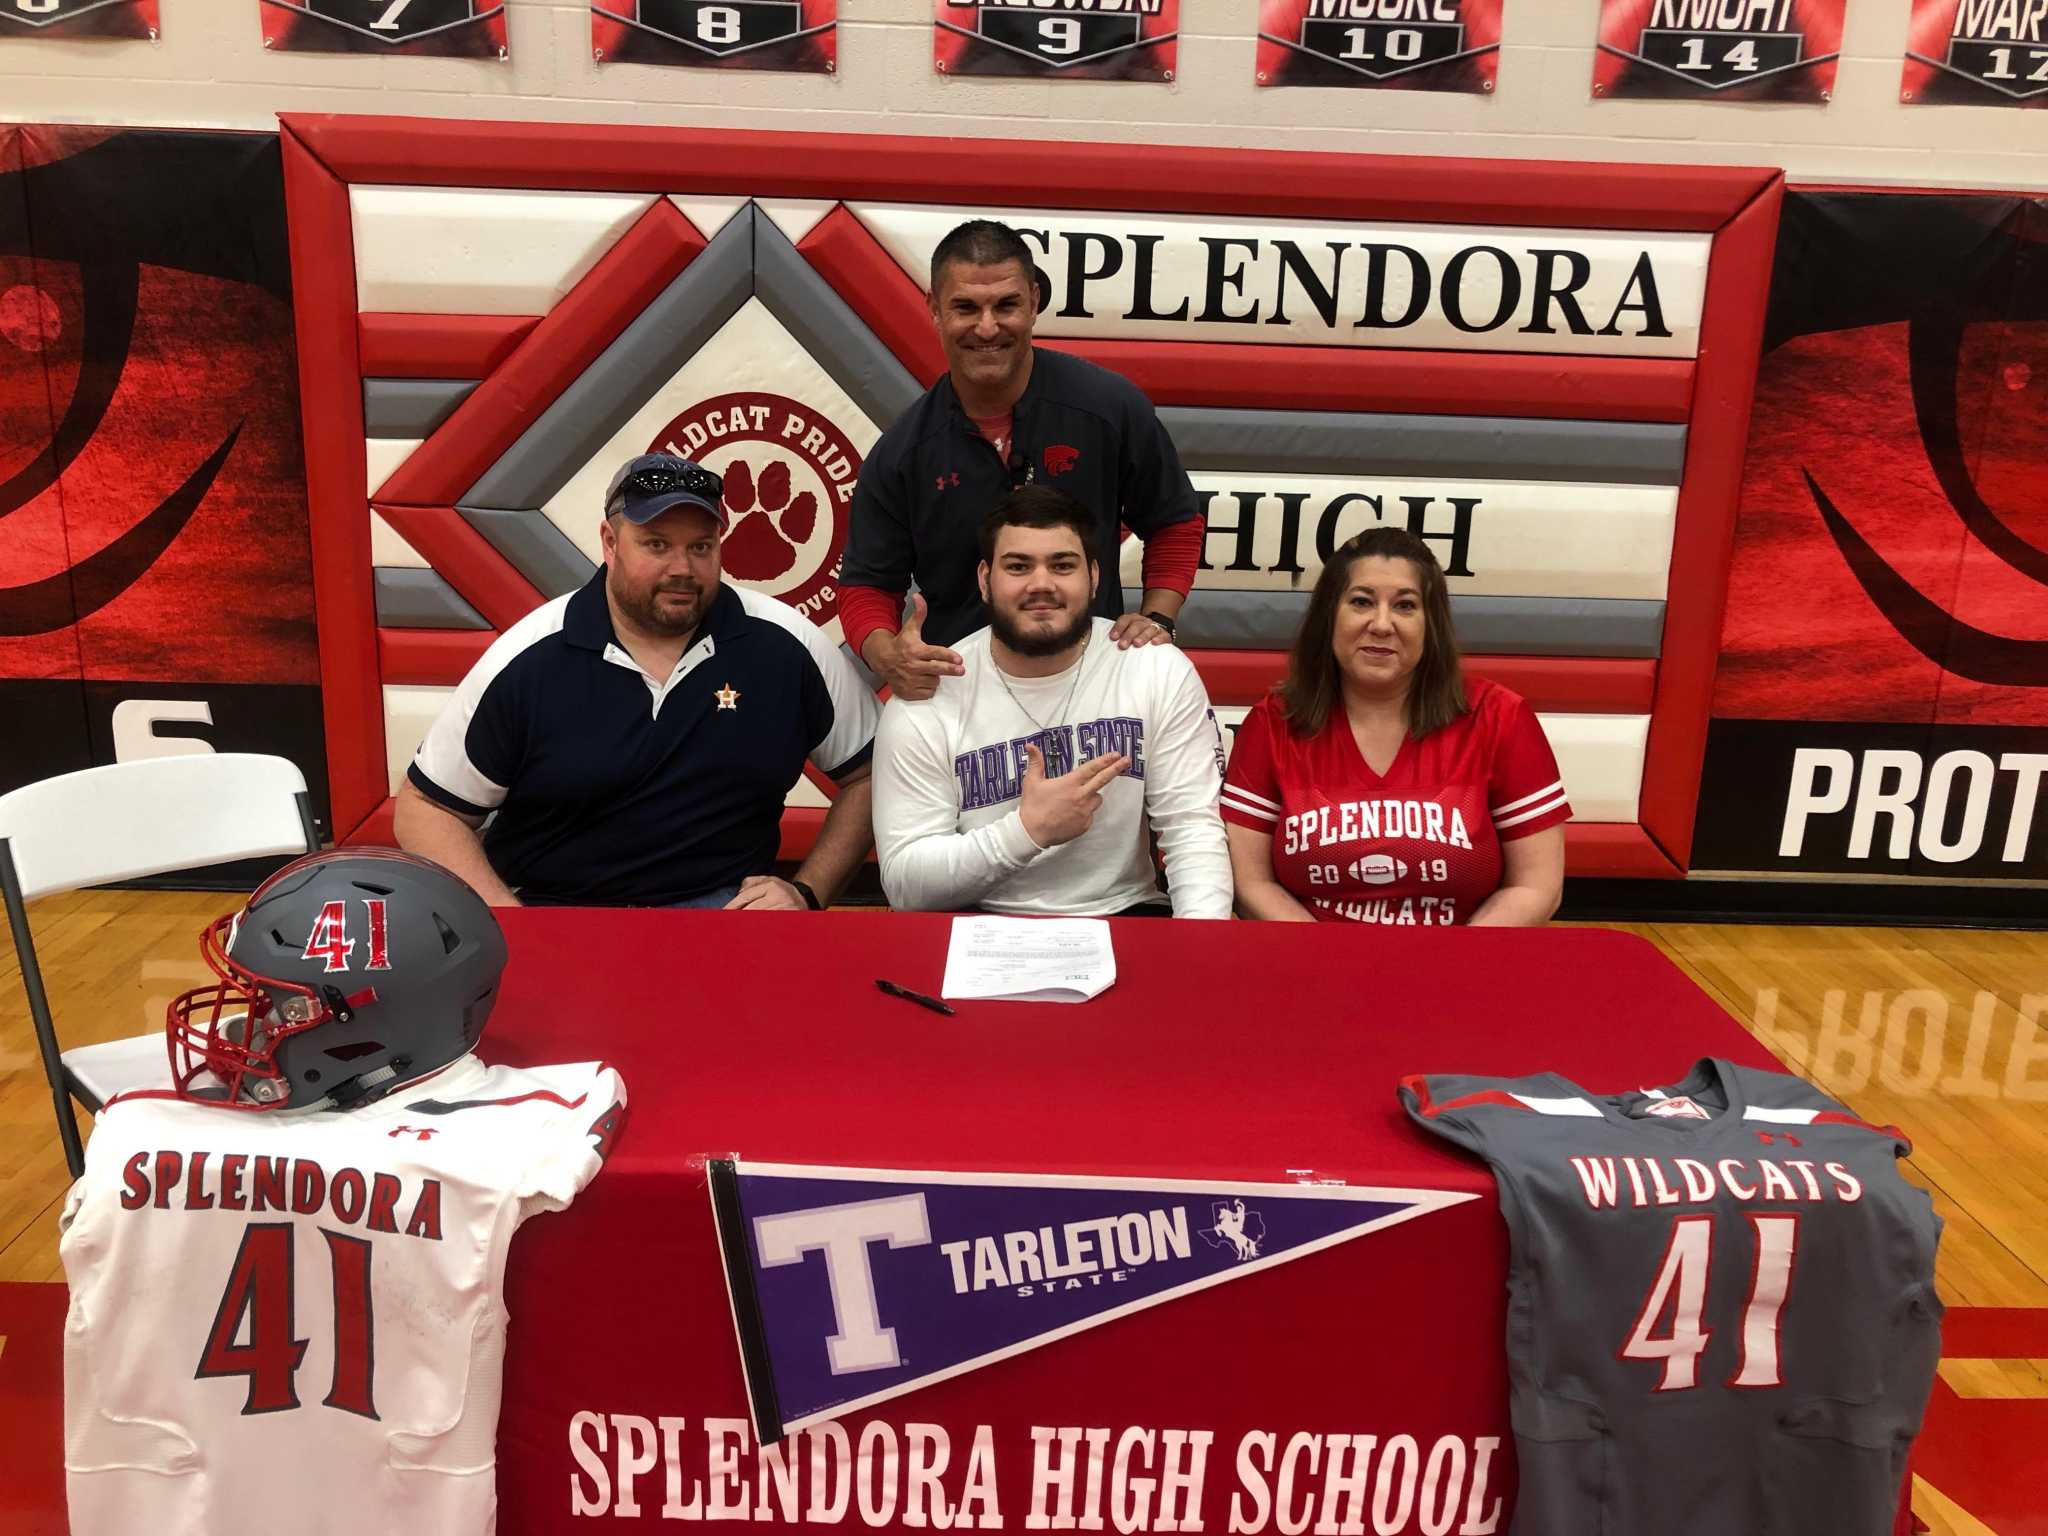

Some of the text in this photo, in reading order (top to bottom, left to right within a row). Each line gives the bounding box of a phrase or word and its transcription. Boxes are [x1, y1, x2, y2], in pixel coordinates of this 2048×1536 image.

[697, 6, 740, 43] 8
[1038, 18, 1081, 54] 9
[1339, 28, 1422, 61] 10
[1676, 39, 1760, 71] 14
[665, 405, 770, 460] LDCAT
[1285, 800, 1473, 855] SPLENDORA
[1308, 859, 1447, 884] 20 19
[301, 899, 392, 973] 41
[120, 1150, 443, 1241] SPLENDORA
[1569, 1156, 1865, 1209] WILDCATS
[940, 1206, 1192, 1294] TARLETON
[752, 1192, 932, 1375] T
[1617, 1211, 1800, 1393] 41
[194, 1222, 382, 1422] 41
[569, 1410, 1502, 1536] SPLENDORA HIGH SCHOOL
